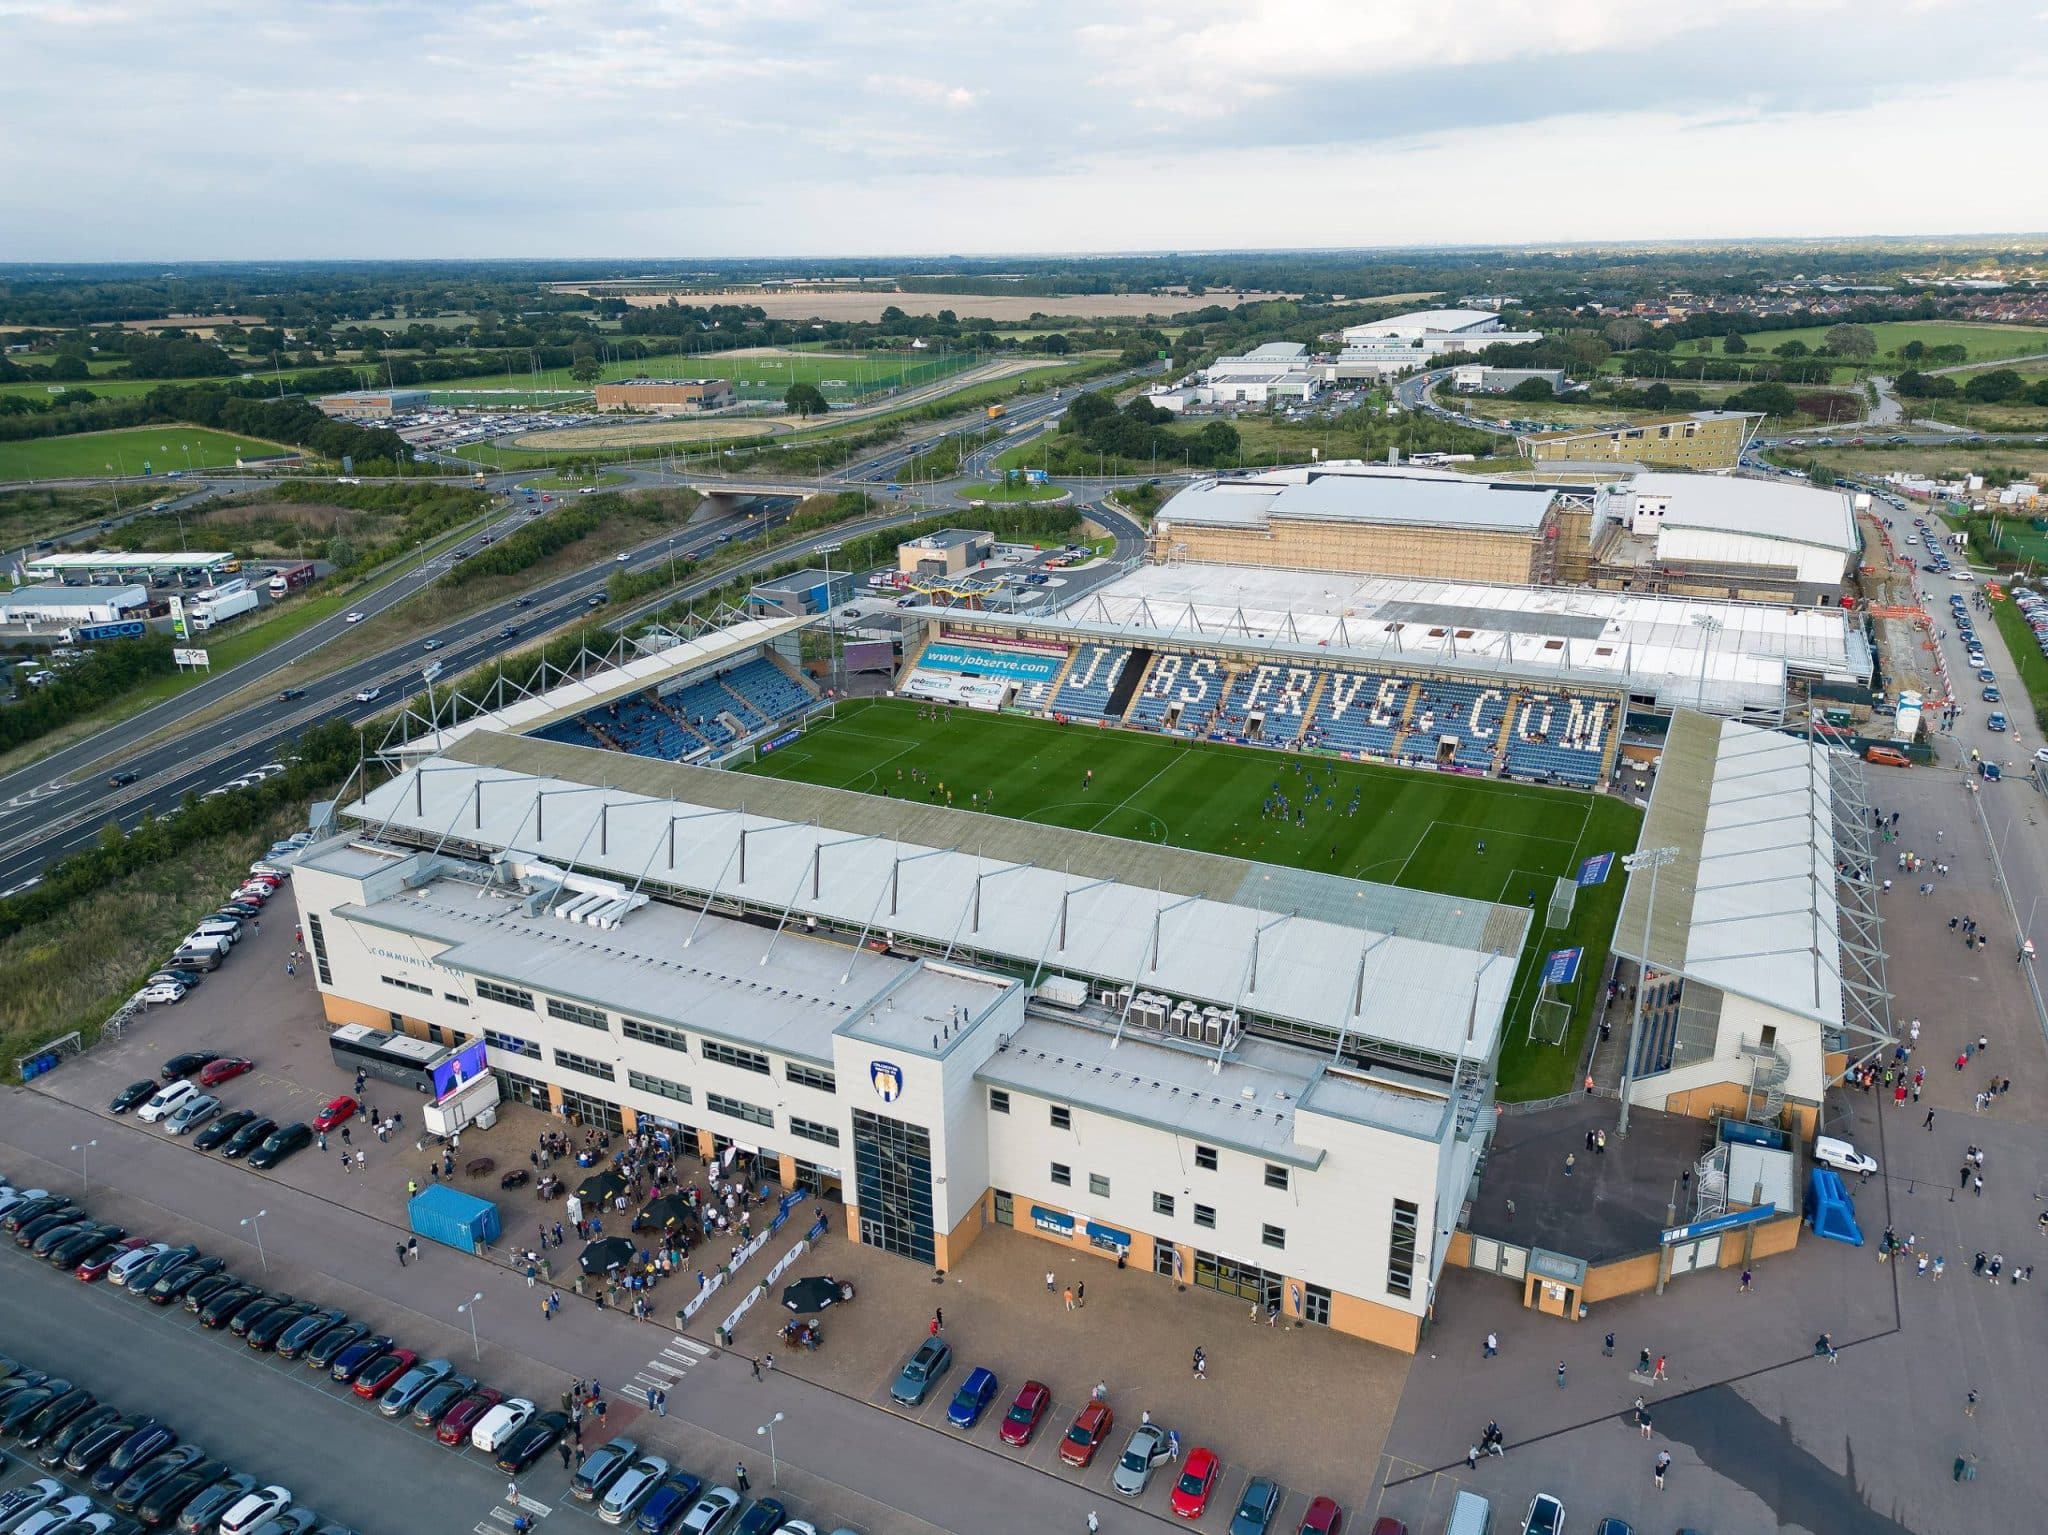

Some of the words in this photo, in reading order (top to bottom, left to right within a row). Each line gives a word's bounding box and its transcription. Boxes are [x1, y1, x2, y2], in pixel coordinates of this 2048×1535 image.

[86, 623, 143, 640] TESCO
[927, 651, 1049, 673] www.jobserve.com
[910, 677, 951, 688] jobserve
[960, 685, 1000, 696] jobserve
[371, 947, 433, 968] COMMUNITY
